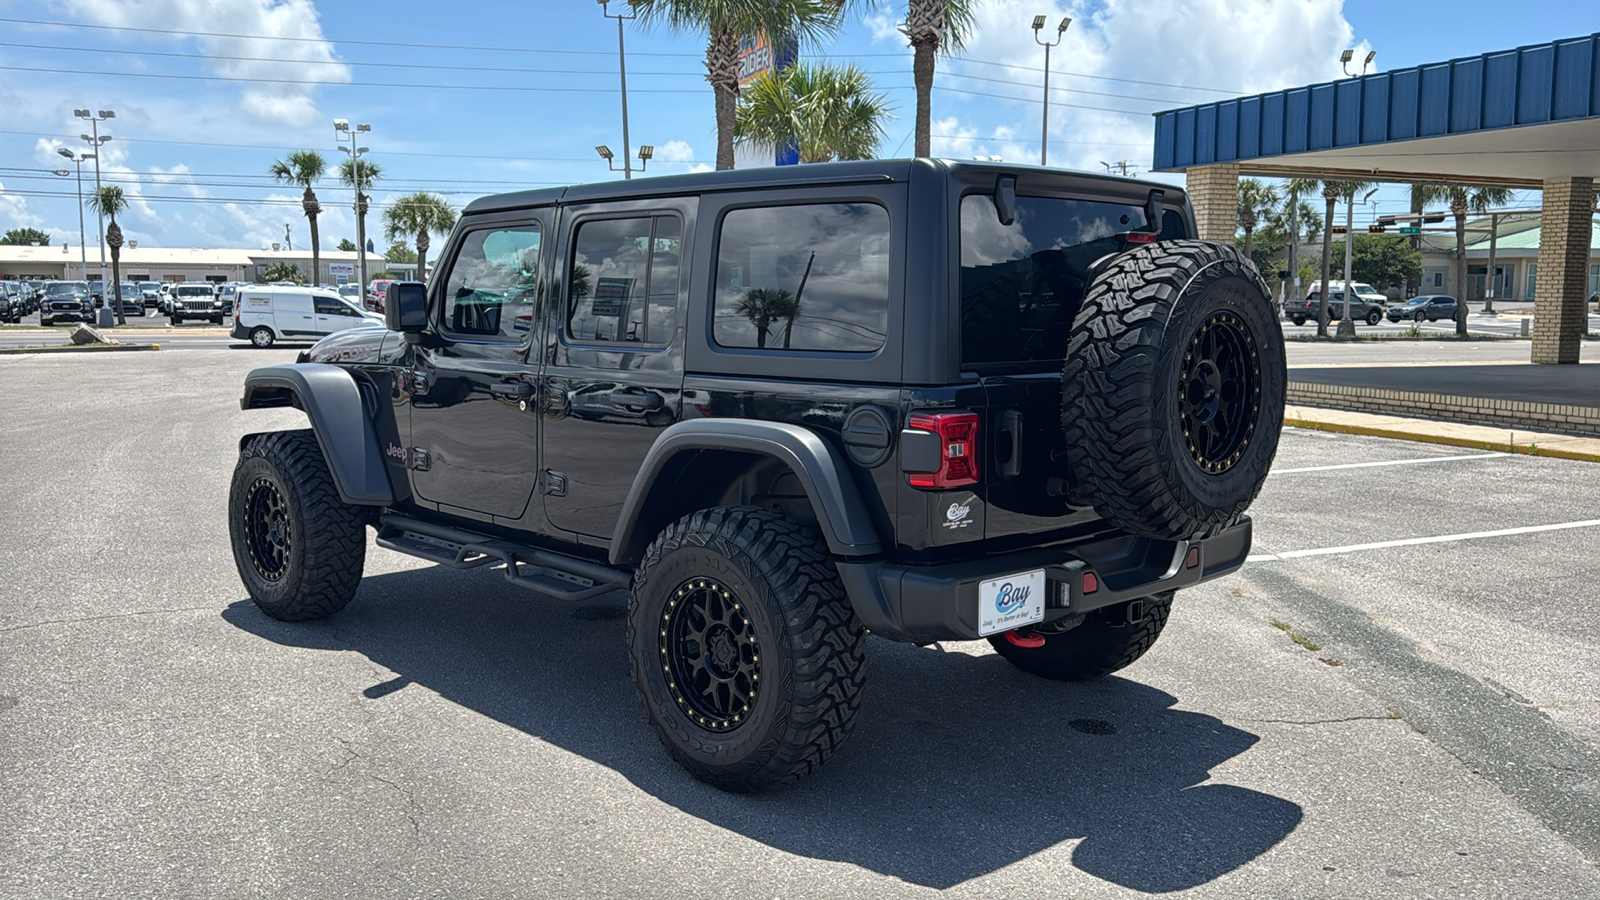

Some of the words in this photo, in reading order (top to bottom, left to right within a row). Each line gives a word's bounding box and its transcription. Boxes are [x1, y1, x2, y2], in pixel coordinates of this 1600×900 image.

[386, 441, 408, 462] Jeep
[947, 502, 970, 520] Bay
[998, 582, 1031, 609] Bay
